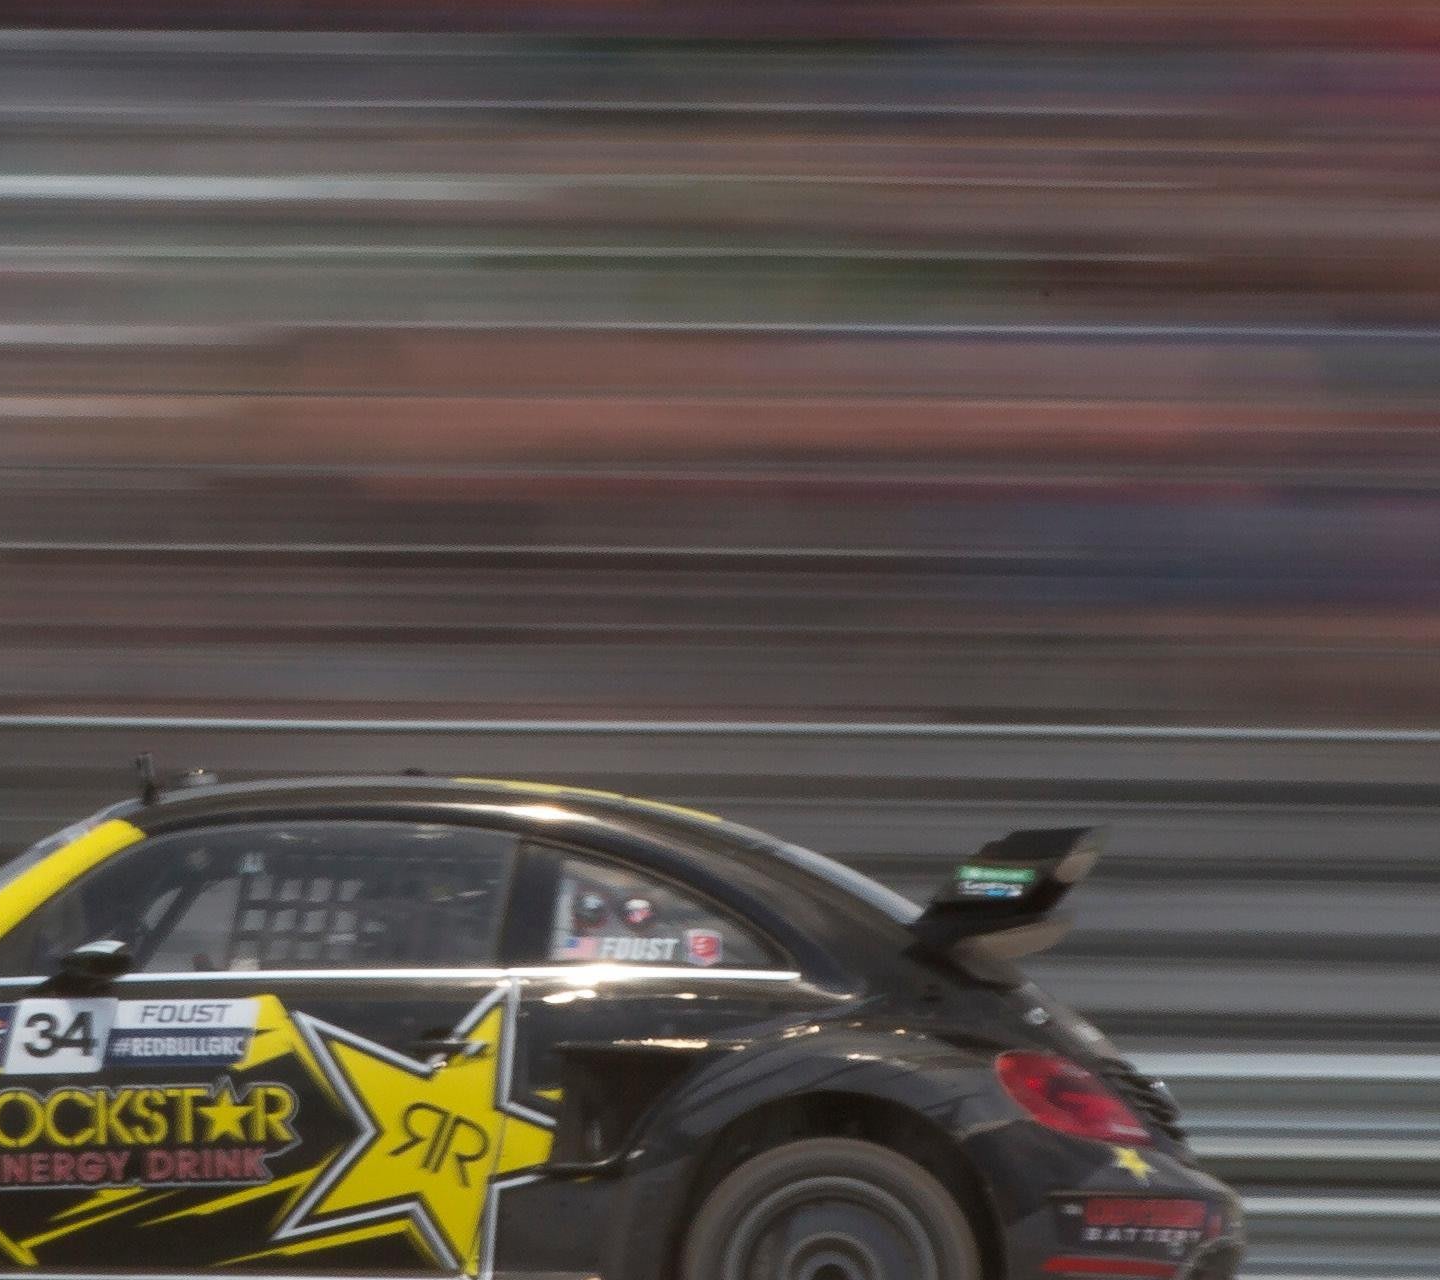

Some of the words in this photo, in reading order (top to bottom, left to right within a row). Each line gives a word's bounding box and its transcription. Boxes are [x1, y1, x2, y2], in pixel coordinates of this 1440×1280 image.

[600, 937, 680, 960] FOUST
[140, 1004, 233, 1024] FOUST
[23, 1011, 98, 1058] 34
[142, 1147, 267, 1183] DRINK
